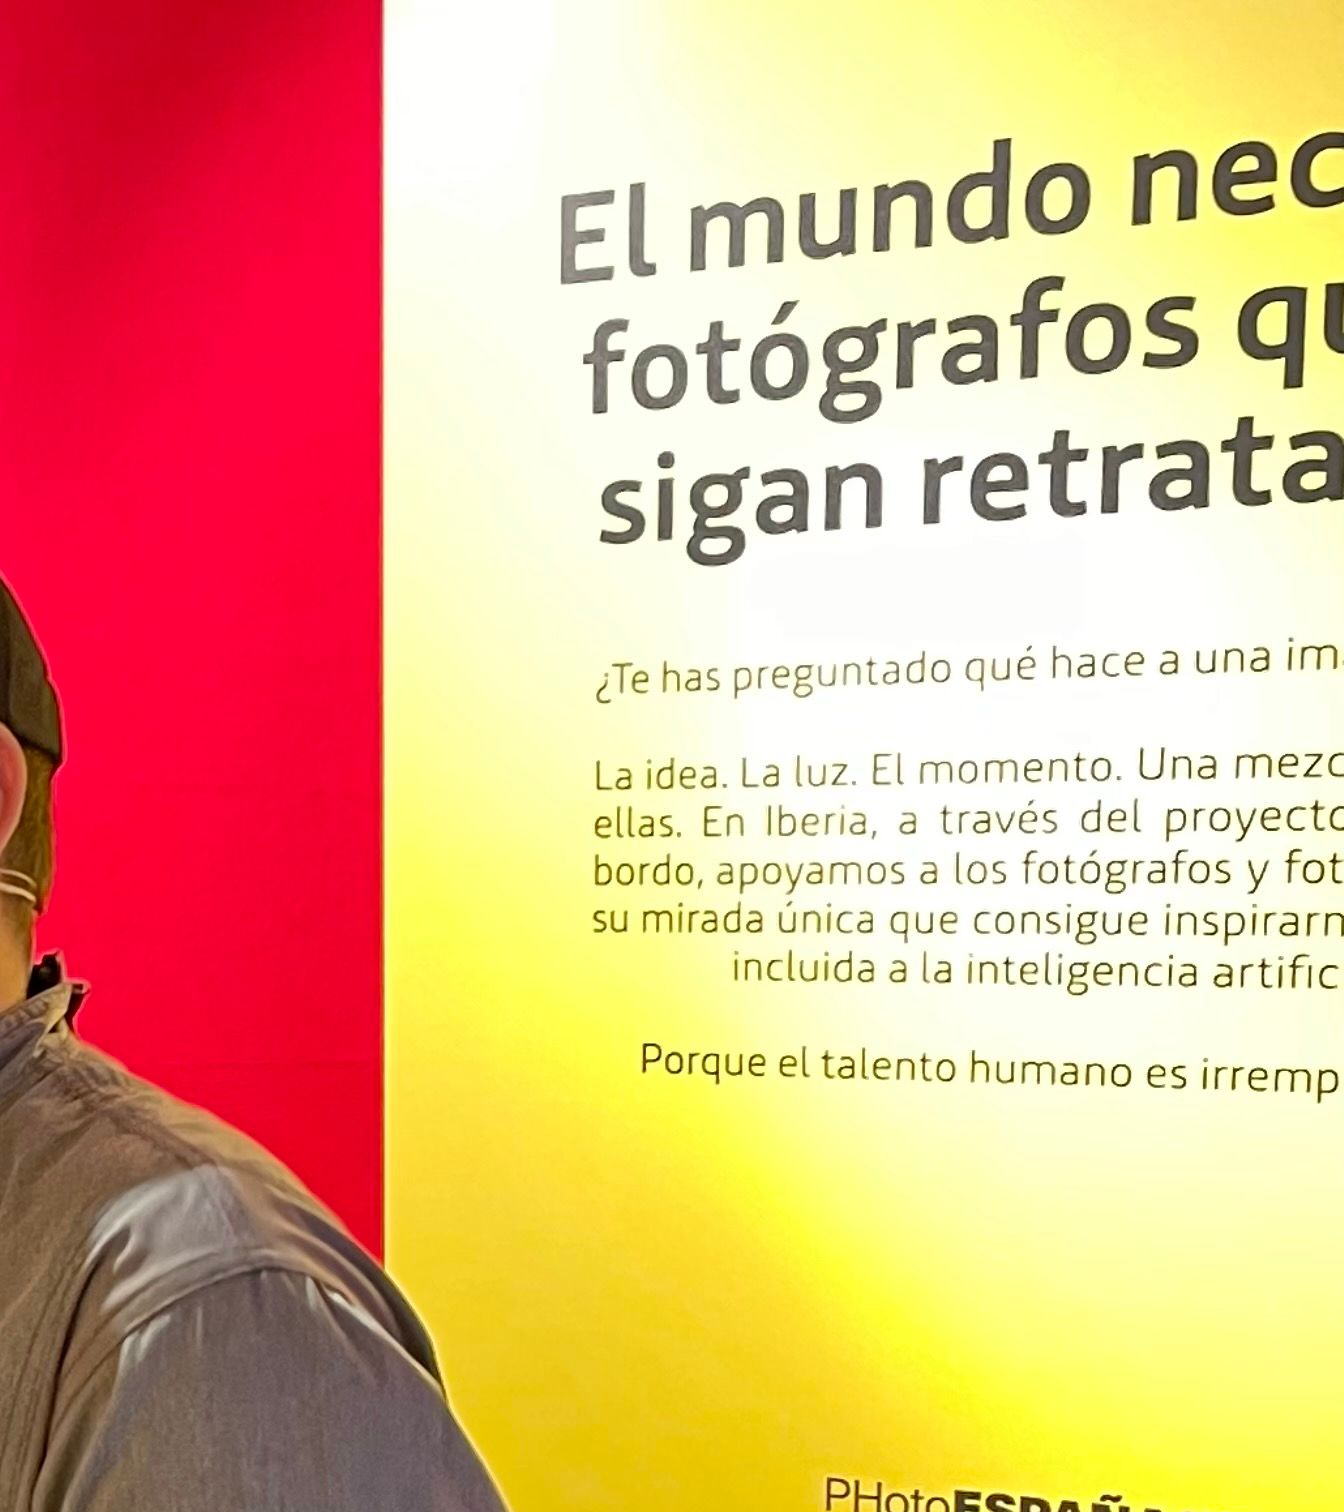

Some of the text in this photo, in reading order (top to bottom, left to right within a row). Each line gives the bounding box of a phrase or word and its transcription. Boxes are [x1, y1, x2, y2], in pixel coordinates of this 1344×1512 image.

[559, 181, 658, 286] El
[689, 137, 1092, 273] mundo
[582, 274, 1200, 425] fotógrafos
[598, 450, 885, 568] sigan
[595, 636, 1344, 706] ¿Te has preguntado qué hace a una im
[595, 759, 633, 791] La
[646, 758, 729, 791] idea.
[741, 757, 780, 789] La
[795, 754, 858, 788] luz.
[872, 751, 905, 786] El
[919, 758, 1124, 786] momento.
[1138, 746, 1218, 783] Una
[594, 805, 683, 840] ellas.
[703, 805, 745, 839] En
[766, 804, 878, 841] Iberia,
[898, 811, 918, 837] a
[939, 799, 1058, 837] través
[1080, 797, 1142, 835] del
[594, 852, 705, 891] bordo,
[716, 861, 905, 896] apoyamos
[919, 861, 939, 886] a
[955, 851, 1007, 886] los
[1021, 847, 1232, 896] fotógrafos
[1246, 858, 1270, 896] y
[592, 909, 629, 934] su
[642, 901, 765, 935] mirada
[778, 900, 874, 936] única
[889, 910, 959, 944] que
[973, 903, 1149, 946] consigue
[733, 948, 876, 984] incluida
[888, 959, 908, 984] a
[922, 950, 954, 986] la
[967, 951, 1199, 997] inteligencia
[641, 1042, 767, 1084] Porque
[778, 1045, 811, 1080] el
[820, 1048, 957, 1083] talento
[969, 1049, 1134, 1088] humano
[1146, 1063, 1188, 1090] es
